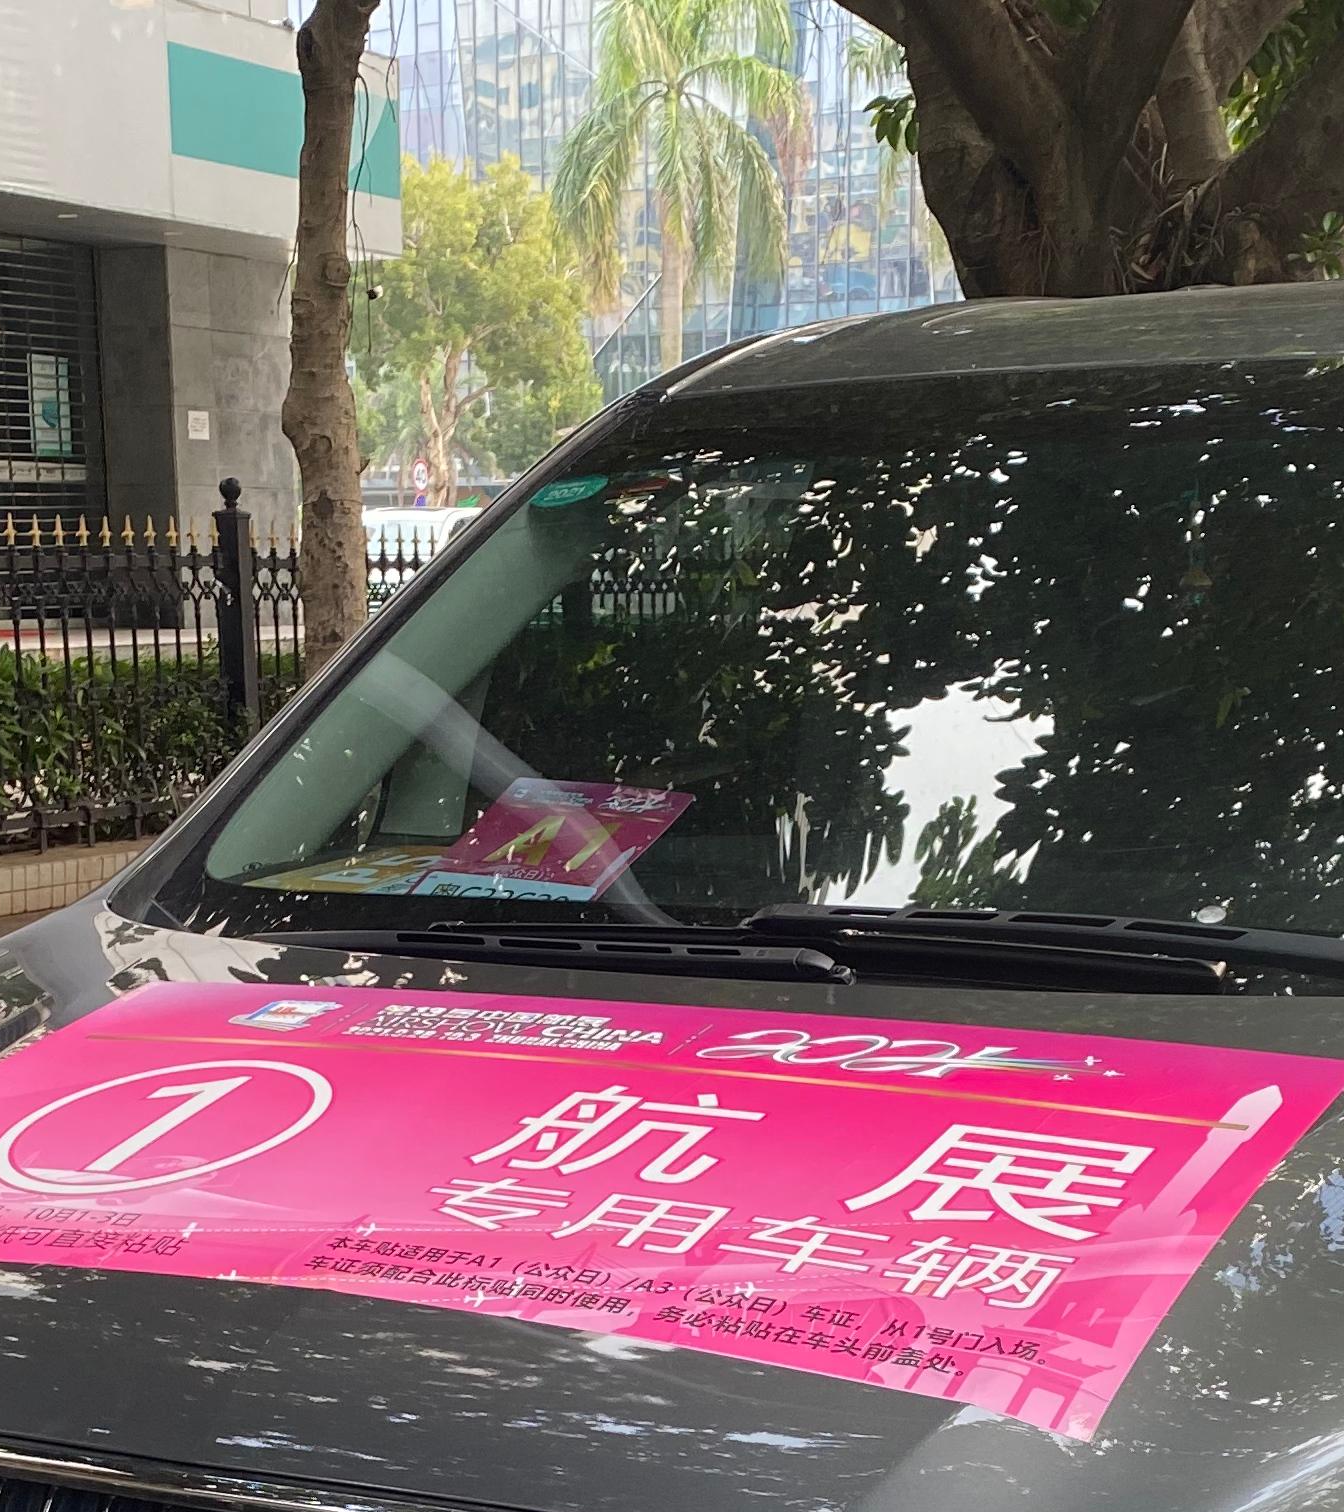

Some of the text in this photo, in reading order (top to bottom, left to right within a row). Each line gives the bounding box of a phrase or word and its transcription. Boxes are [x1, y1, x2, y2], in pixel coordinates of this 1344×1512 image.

[482, 815, 622, 871] A1
[357, 1015, 665, 1045] AIRSHOW CHINA
[430, 1175, 1079, 1311] 专用车辆
